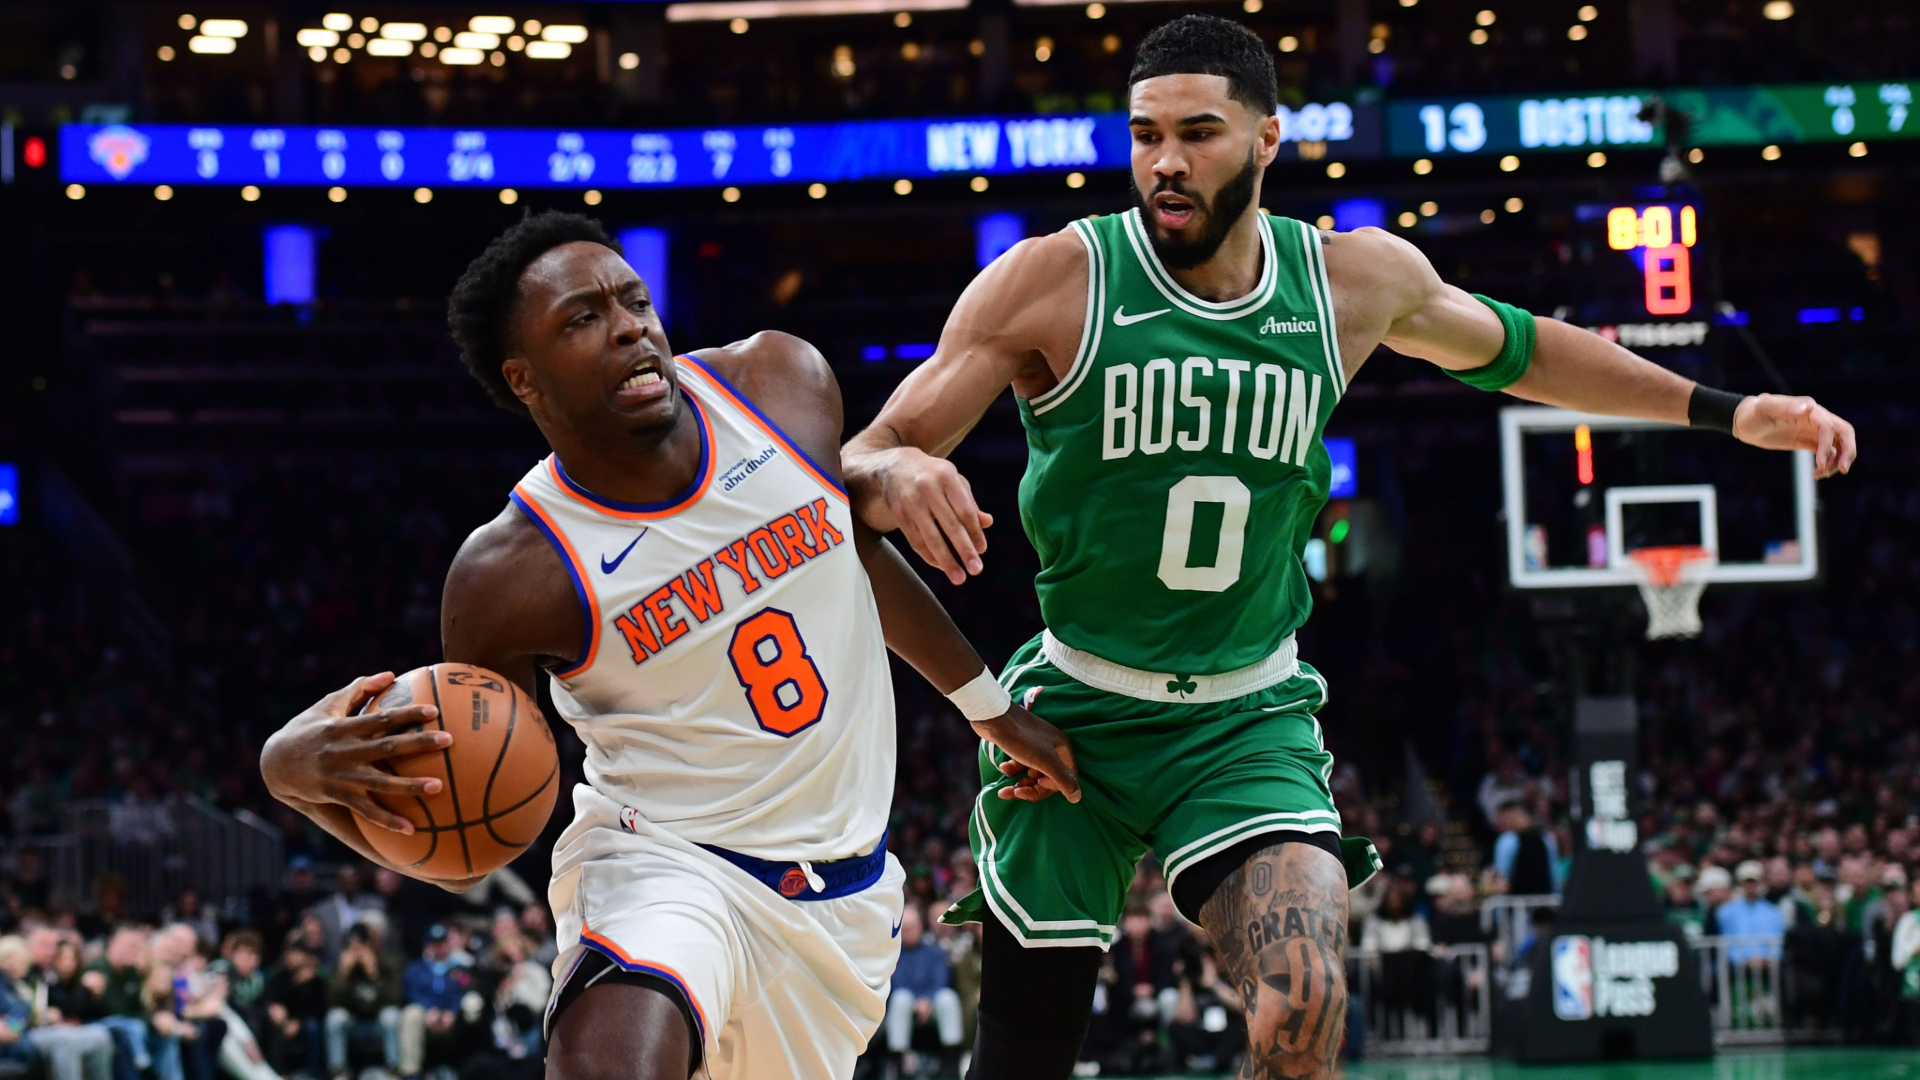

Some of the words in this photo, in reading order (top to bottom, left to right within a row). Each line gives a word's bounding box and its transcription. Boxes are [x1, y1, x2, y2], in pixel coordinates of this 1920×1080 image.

[927, 121, 1000, 171] NEW
[1005, 117, 1098, 168] YORK
[1419, 102, 1487, 152] 13
[1607, 205, 1697, 250] 8:01
[1644, 243, 1691, 315] 8
[1259, 316, 1318, 335] Amica
[1102, 356, 1322, 467] BOSTON
[724, 471, 747, 491] abu
[745, 444, 777, 474] dhabi
[1157, 475, 1251, 592] 0
[613, 558, 724, 666] NEW
[714, 497, 845, 595] YORK
[727, 606, 829, 738] 8
[1592, 936, 1679, 979] League
[1594, 979, 1657, 1017] Pass
